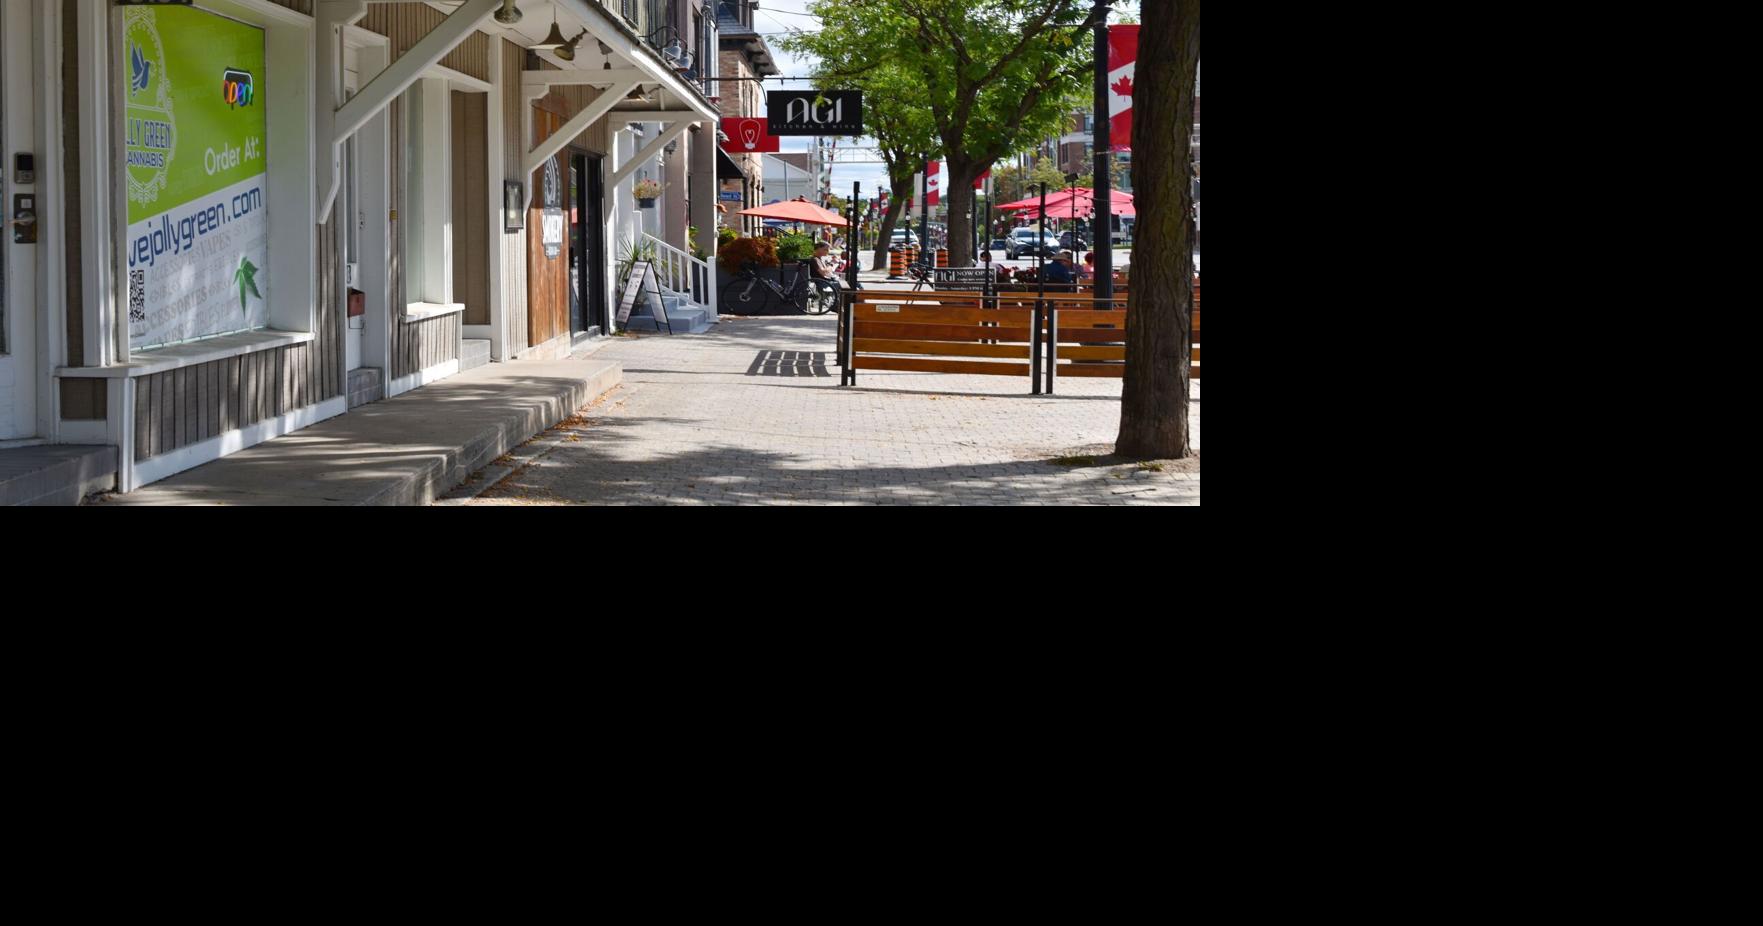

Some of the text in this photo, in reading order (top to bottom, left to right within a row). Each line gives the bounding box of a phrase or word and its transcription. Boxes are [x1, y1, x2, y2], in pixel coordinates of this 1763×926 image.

[224, 80, 254, 108] open
[786, 97, 842, 124] AGI
[127, 118, 171, 149] LY GREEN
[127, 151, 164, 168] ANNABIS
[204, 136, 260, 176] Order At:
